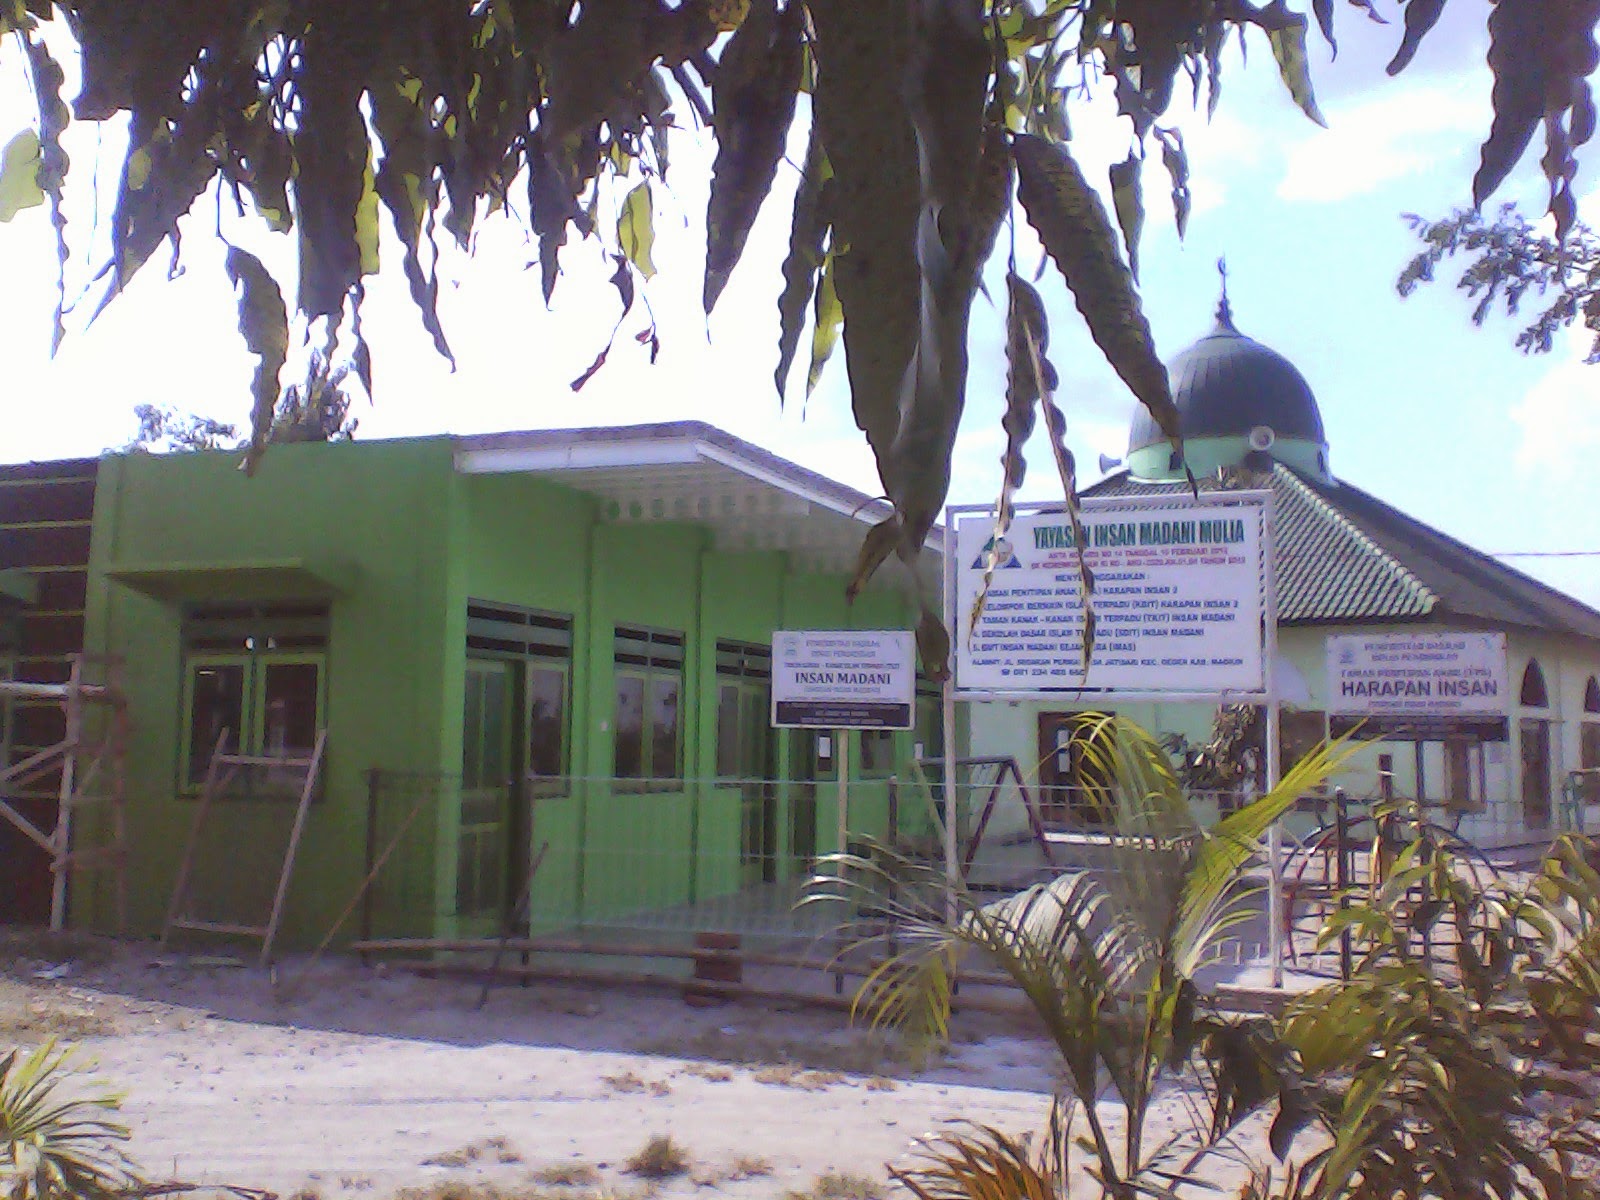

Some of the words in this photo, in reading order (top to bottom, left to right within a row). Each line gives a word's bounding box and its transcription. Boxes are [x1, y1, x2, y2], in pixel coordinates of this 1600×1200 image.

[1033, 525, 1090, 549] YAYASN
[1094, 523, 1136, 547] INSAN
[1139, 521, 1195, 545] MADANI
[1199, 519, 1244, 544] MULIA
[795, 672, 834, 684] INSAN
[837, 673, 891, 684] MADANI
[1342, 680, 1431, 697] HARAPAN
[1438, 679, 1498, 696] INSAN
